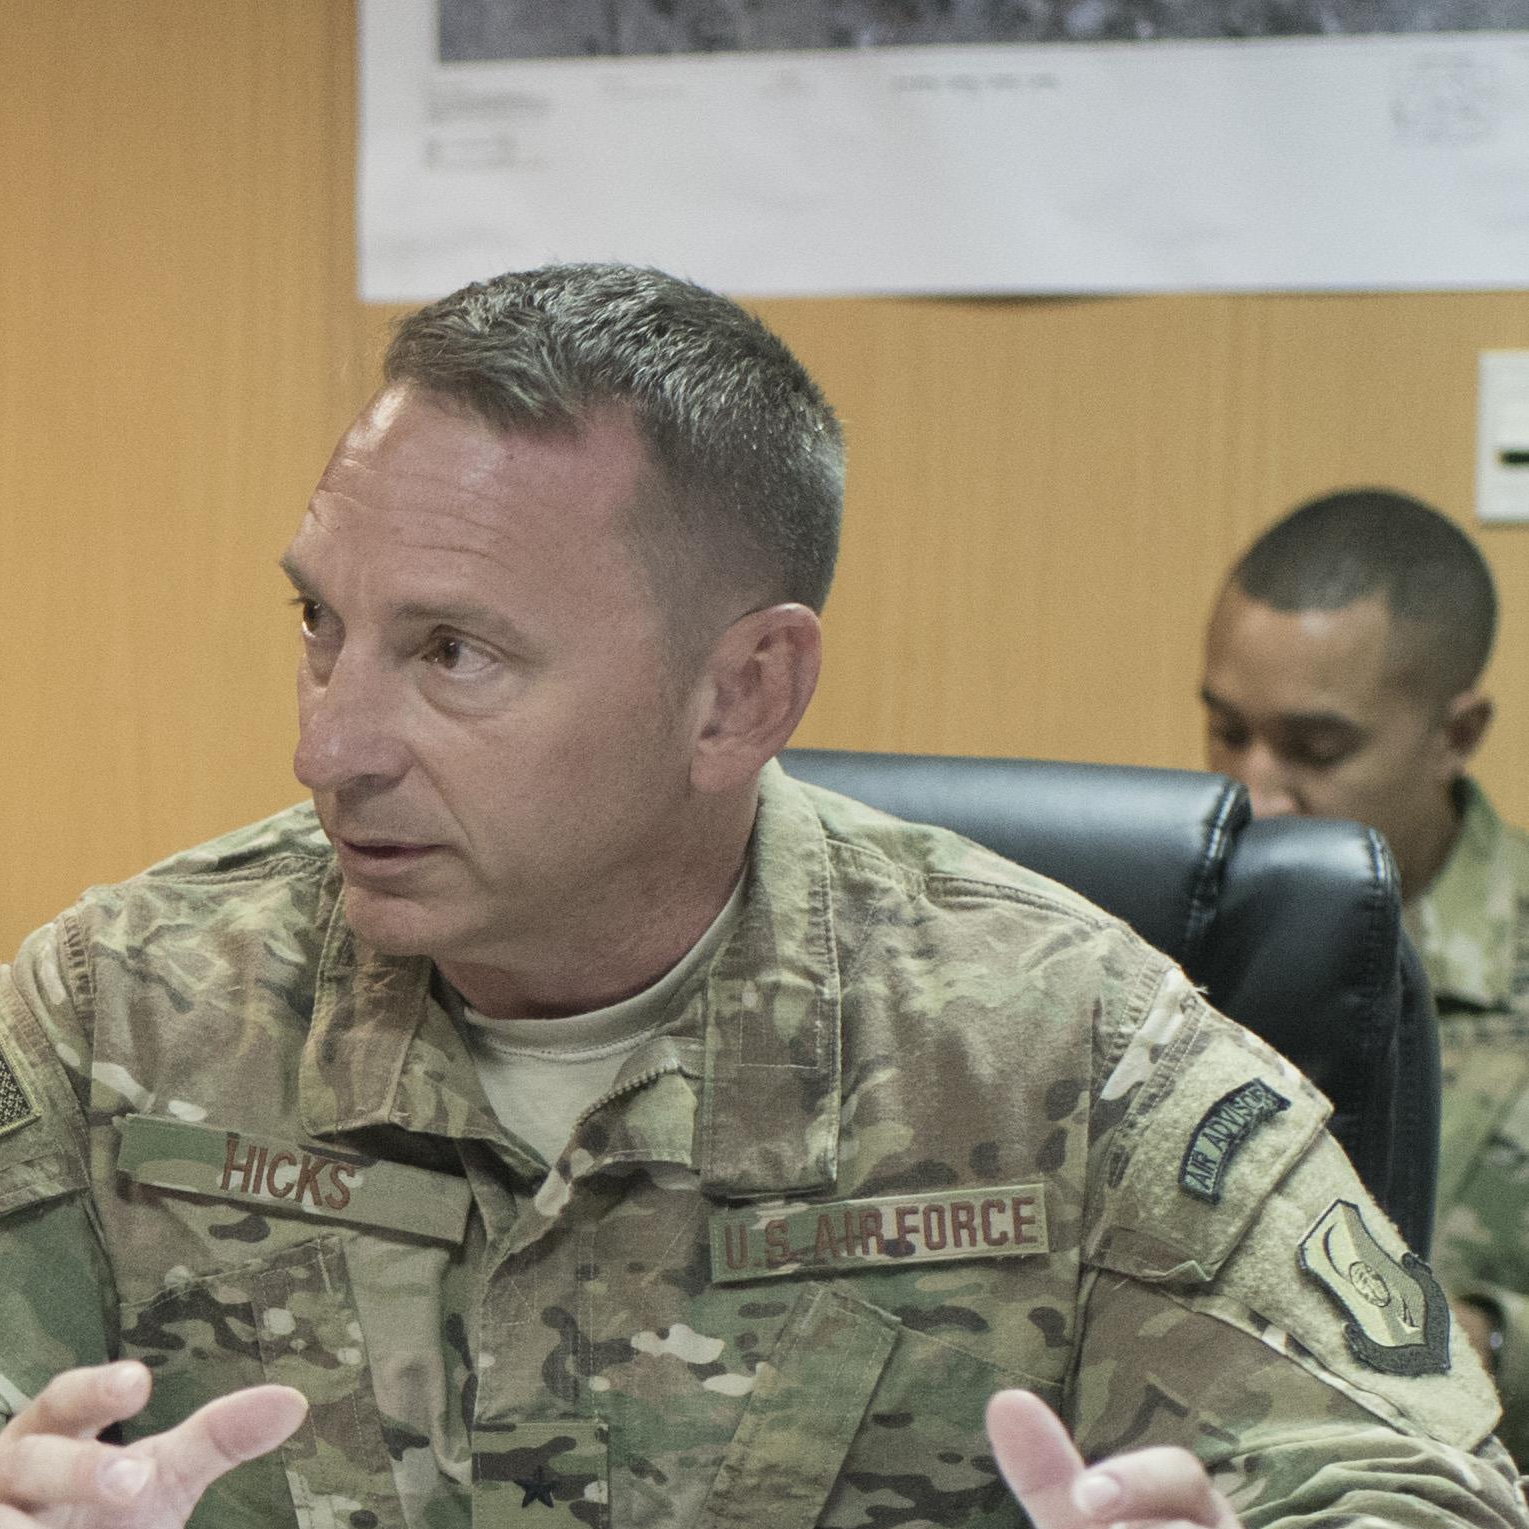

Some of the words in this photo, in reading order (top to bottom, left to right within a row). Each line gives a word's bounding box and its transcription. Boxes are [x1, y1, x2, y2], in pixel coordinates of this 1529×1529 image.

[220, 1136, 356, 1210] HICKS
[1186, 1151, 1217, 1190] AIR
[813, 1207, 888, 1259] AIR
[895, 1196, 1039, 1252] FORCE
